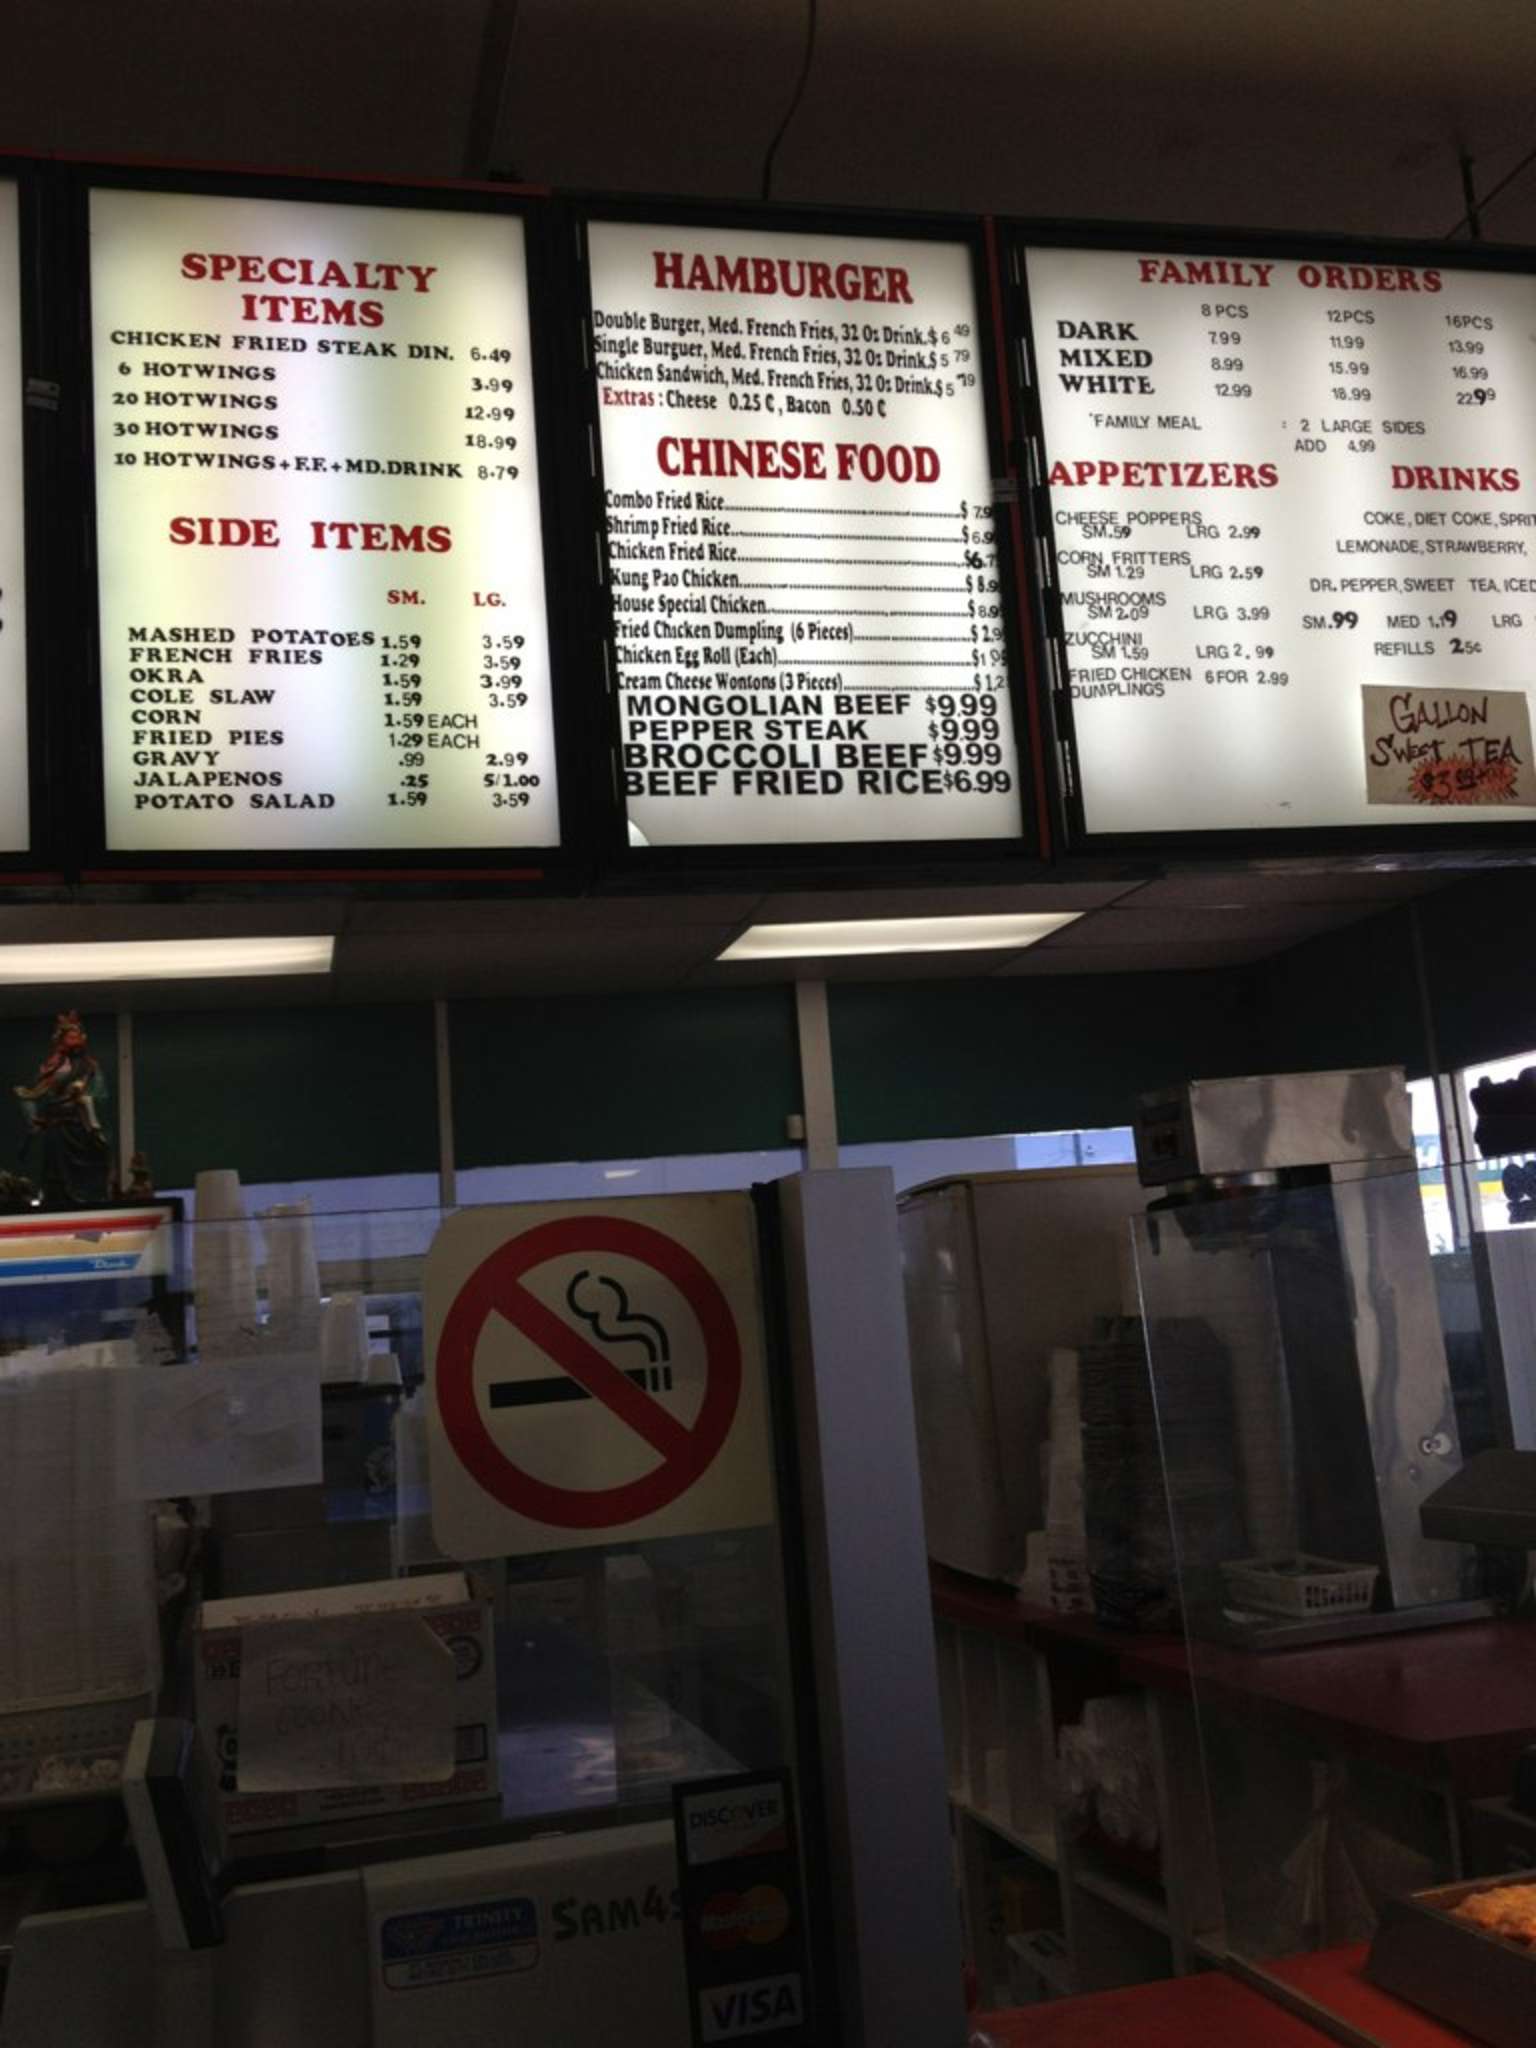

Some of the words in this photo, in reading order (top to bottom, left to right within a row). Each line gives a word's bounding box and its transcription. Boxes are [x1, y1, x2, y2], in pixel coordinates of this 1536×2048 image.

[180, 252, 437, 293] SPECIALTY
[653, 252, 914, 304] HAMBURGER
[1139, 259, 1274, 288] FAMILY
[1298, 265, 1442, 292] ORDERS
[242, 294, 384, 327] ITEMS
[594, 310, 646, 331] Double
[708, 316, 742, 336] Med.
[747, 318, 796, 338] French
[111, 330, 221, 348] CHICKEN
[232, 334, 307, 353] FRIED
[317, 339, 398, 358] STEAK
[408, 343, 455, 361] DIN.
[470, 347, 511, 363] 6.49
[1056, 321, 1138, 342] DARK
[1208, 332, 1241, 346] 7.99
[1330, 336, 1364, 350] 11.99
[1449, 342, 1484, 355] 13.99
[594, 337, 638, 357] Single
[711, 342, 745, 361] Med.
[750, 345, 799, 364] French
[119, 361, 131, 376] 6
[143, 362, 276, 382] HOTWINGS
[471, 377, 513, 393] 3.99
[597, 360, 653, 380] Chicken
[732, 368, 765, 387] Med.
[768, 370, 814, 389] French
[1060, 350, 1152, 368] MIXED
[1210, 358, 1243, 372] 8.99
[1329, 363, 1369, 376] 15.99
[1452, 367, 1488, 381] 16.99
[1060, 375, 1155, 395] WHITE
[1215, 384, 1252, 399] 12.99
[1333, 388, 1371, 403] 18.99
[113, 392, 138, 405] 20
[144, 392, 277, 411] HOTWINGS
[465, 406, 514, 422] 12.99
[603, 388, 655, 407] Extras
[666, 390, 717, 410] Cheese
[730, 392, 760, 411] 0.25
[786, 397, 831, 415] Bacon
[842, 399, 875, 417] 0.50
[1158, 415, 1201, 431] MEAL
[1322, 420, 1371, 434] LARGE
[1382, 421, 1425, 435] SIDES
[114, 422, 139, 437] 30
[145, 421, 278, 440] HOTWINGS
[465, 433, 516, 451] 18.99
[1295, 439, 1326, 454] ADD
[1347, 439, 1375, 453] 4.99
[114, 452, 136, 466] 10
[477, 464, 519, 480] 8.79
[657, 436, 827, 480] CHINESE
[837, 443, 940, 484] FOOD
[1048, 462, 1278, 488] APPETIZERS
[1392, 466, 1520, 492] DRINKS
[605, 489, 653, 510] Combo
[657, 492, 692, 510] Fried
[607, 516, 658, 539] Shrimp
[662, 517, 696, 535] Fried
[1056, 511, 1119, 526] CHEESE
[1127, 512, 1202, 526] POPPERS
[1415, 512, 1446, 526] DIET
[169, 516, 279, 547] SIDE
[311, 522, 452, 552] ITEMS
[1186, 525, 1220, 539] LRG
[1229, 526, 1260, 540] 2.99
[1057, 551, 1103, 565] CORN
[1113, 552, 1192, 565] FRITTERS
[611, 569, 648, 589] Kung
[653, 570, 678, 586] Pao
[1191, 565, 1223, 580] LRG
[1230, 566, 1263, 580] 2.59
[387, 590, 425, 605] SM.
[472, 591, 507, 607] LG.
[613, 593, 654, 612] House
[658, 594, 706, 617] Special
[1061, 592, 1166, 606] MUSHROOMS
[1193, 606, 1229, 620] LRG
[1238, 606, 1270, 620] 3.99
[1387, 616, 1420, 628] MED
[1492, 614, 1522, 627] LRG
[128, 627, 235, 643] MASHED
[251, 628, 375, 647] POTATOES
[381, 634, 421, 650] 1.59
[483, 634, 525, 649] 3.59
[715, 622, 783, 645] Dumpling
[1065, 632, 1143, 648] ZUCCHINI
[129, 648, 232, 663] FRENCH
[249, 648, 323, 665] FRIES
[381, 654, 419, 668] 1.29
[483, 655, 521, 671] 3.59
[676, 648, 699, 668] Egg
[703, 647, 730, 665] Roll
[1375, 642, 1434, 656] REFILLS
[129, 668, 204, 684] OKRA
[382, 673, 420, 689] 1.59
[480, 674, 522, 690] 3.99
[667, 673, 712, 691] Cheese
[716, 673, 777, 691] Wontons
[1069, 668, 1117, 682] FRIED
[1122, 668, 1192, 682] CHICKEN
[1257, 671, 1288, 685] 2.99
[130, 688, 194, 705] COLE
[209, 688, 275, 705] SLAW
[384, 692, 422, 707] 1.59
[489, 692, 528, 708] 3.59
[1071, 684, 1164, 698] DUMPLINGS
[627, 694, 824, 716] MONGOLIAN
[834, 694, 911, 715] BEEF
[925, 695, 997, 717] $9.99
[1390, 693, 1488, 734] GALLON
[131, 708, 202, 725] CORN
[384, 713, 423, 729] 1.59
[428, 713, 477, 729] EACH
[132, 730, 213, 746] FRIED
[229, 729, 284, 745] PIES
[389, 733, 423, 747] 1.29
[428, 733, 480, 749] EACH
[629, 720, 754, 741] PEPPER
[765, 719, 868, 740] STEAK
[929, 719, 999, 742] $9.99
[132, 750, 220, 766] GRAVY
[398, 753, 424, 767] .99
[486, 752, 528, 767] 2.99
[624, 744, 821, 768] BROCCOLI
[837, 744, 928, 767] BEEF
[932, 744, 1000, 766] $9.99
[1460, 735, 1521, 766] TEA
[134, 771, 283, 788] JALAPENOS
[401, 774, 429, 789] .25
[624, 770, 718, 796] BEEF
[735, 770, 844, 795] FRIED
[135, 793, 234, 810] POTATO
[249, 792, 335, 809] SALAD
[387, 792, 427, 807] 1.59
[492, 792, 530, 807] 3.59
[711, 1985, 796, 2030] VISA
